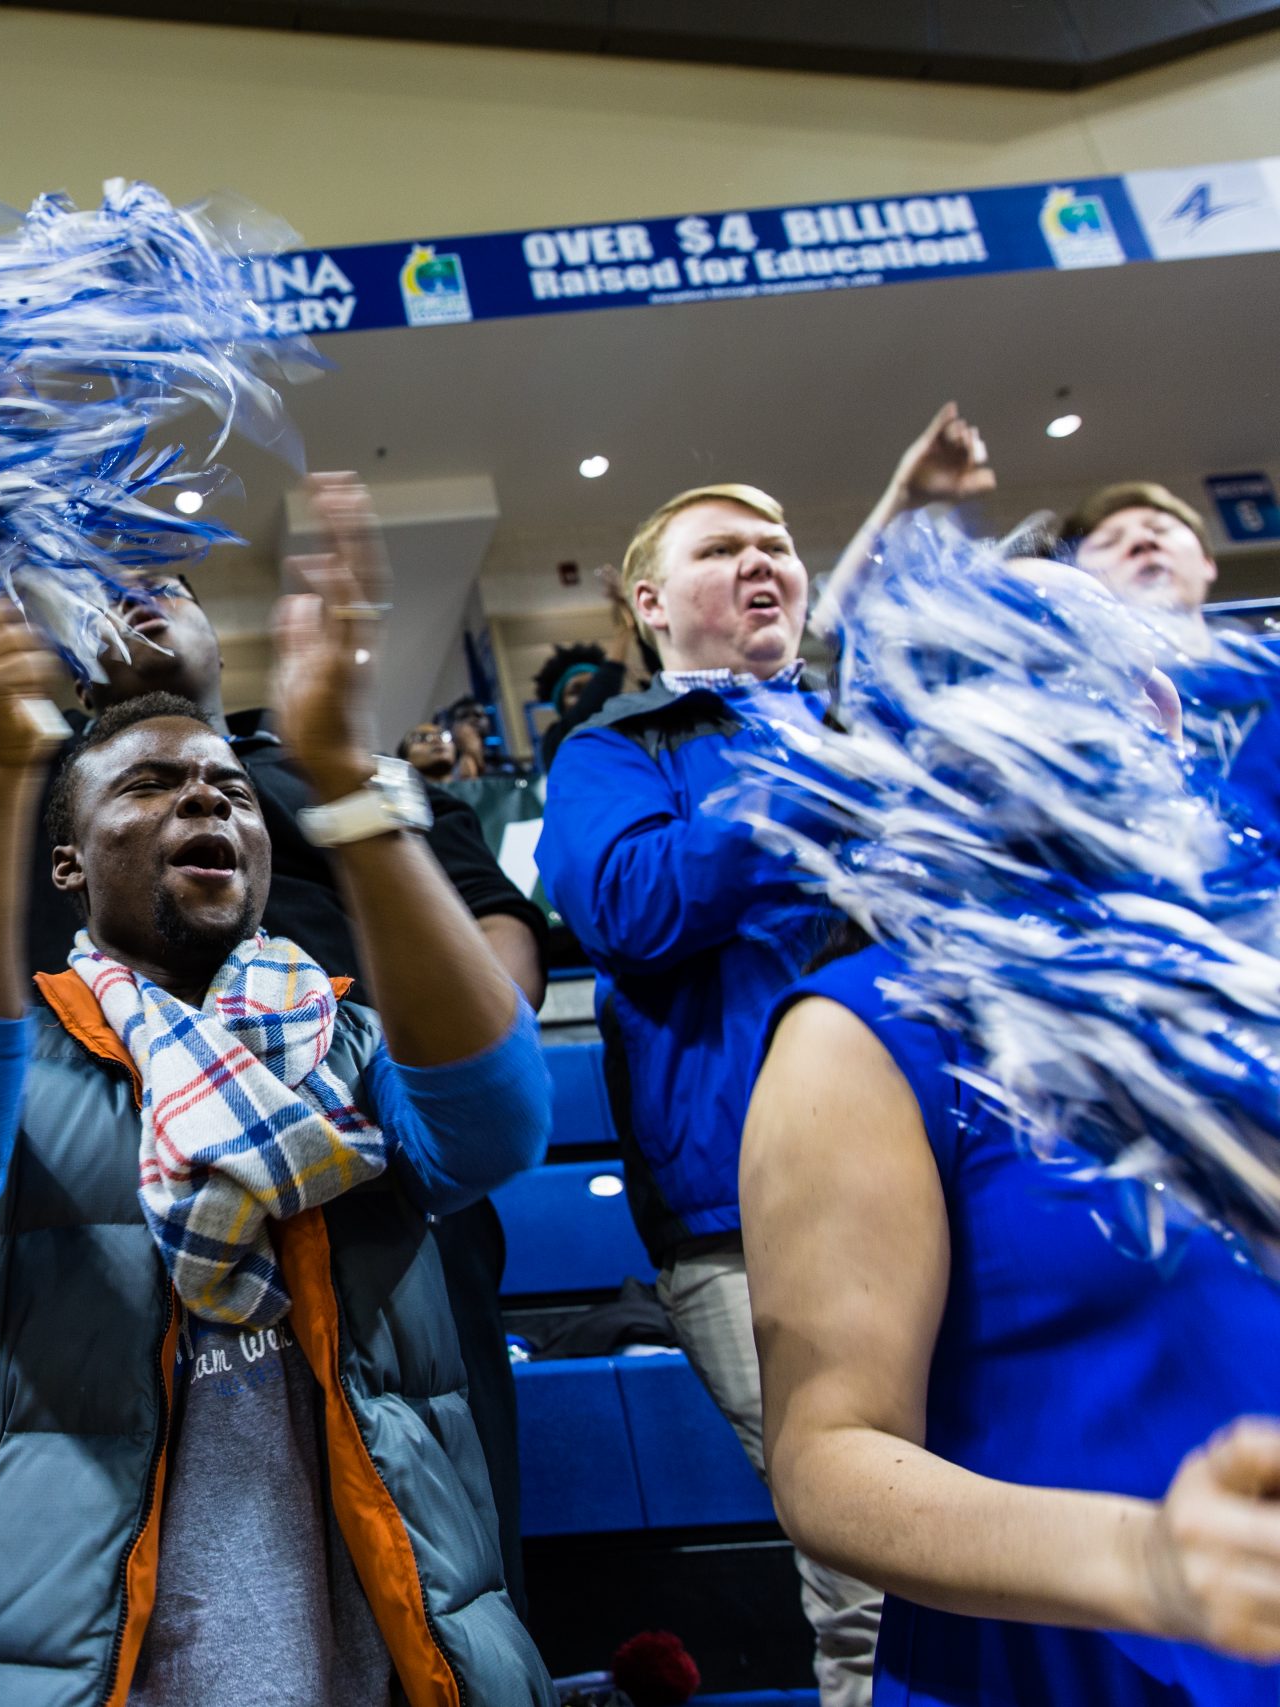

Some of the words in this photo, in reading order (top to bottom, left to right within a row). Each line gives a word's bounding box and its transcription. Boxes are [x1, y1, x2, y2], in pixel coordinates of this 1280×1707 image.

[523, 223, 654, 268] OVER
[781, 195, 978, 247] BILLION
[529, 256, 681, 300] Raised
[683, 254, 749, 287] for
[753, 230, 989, 281] Education!
